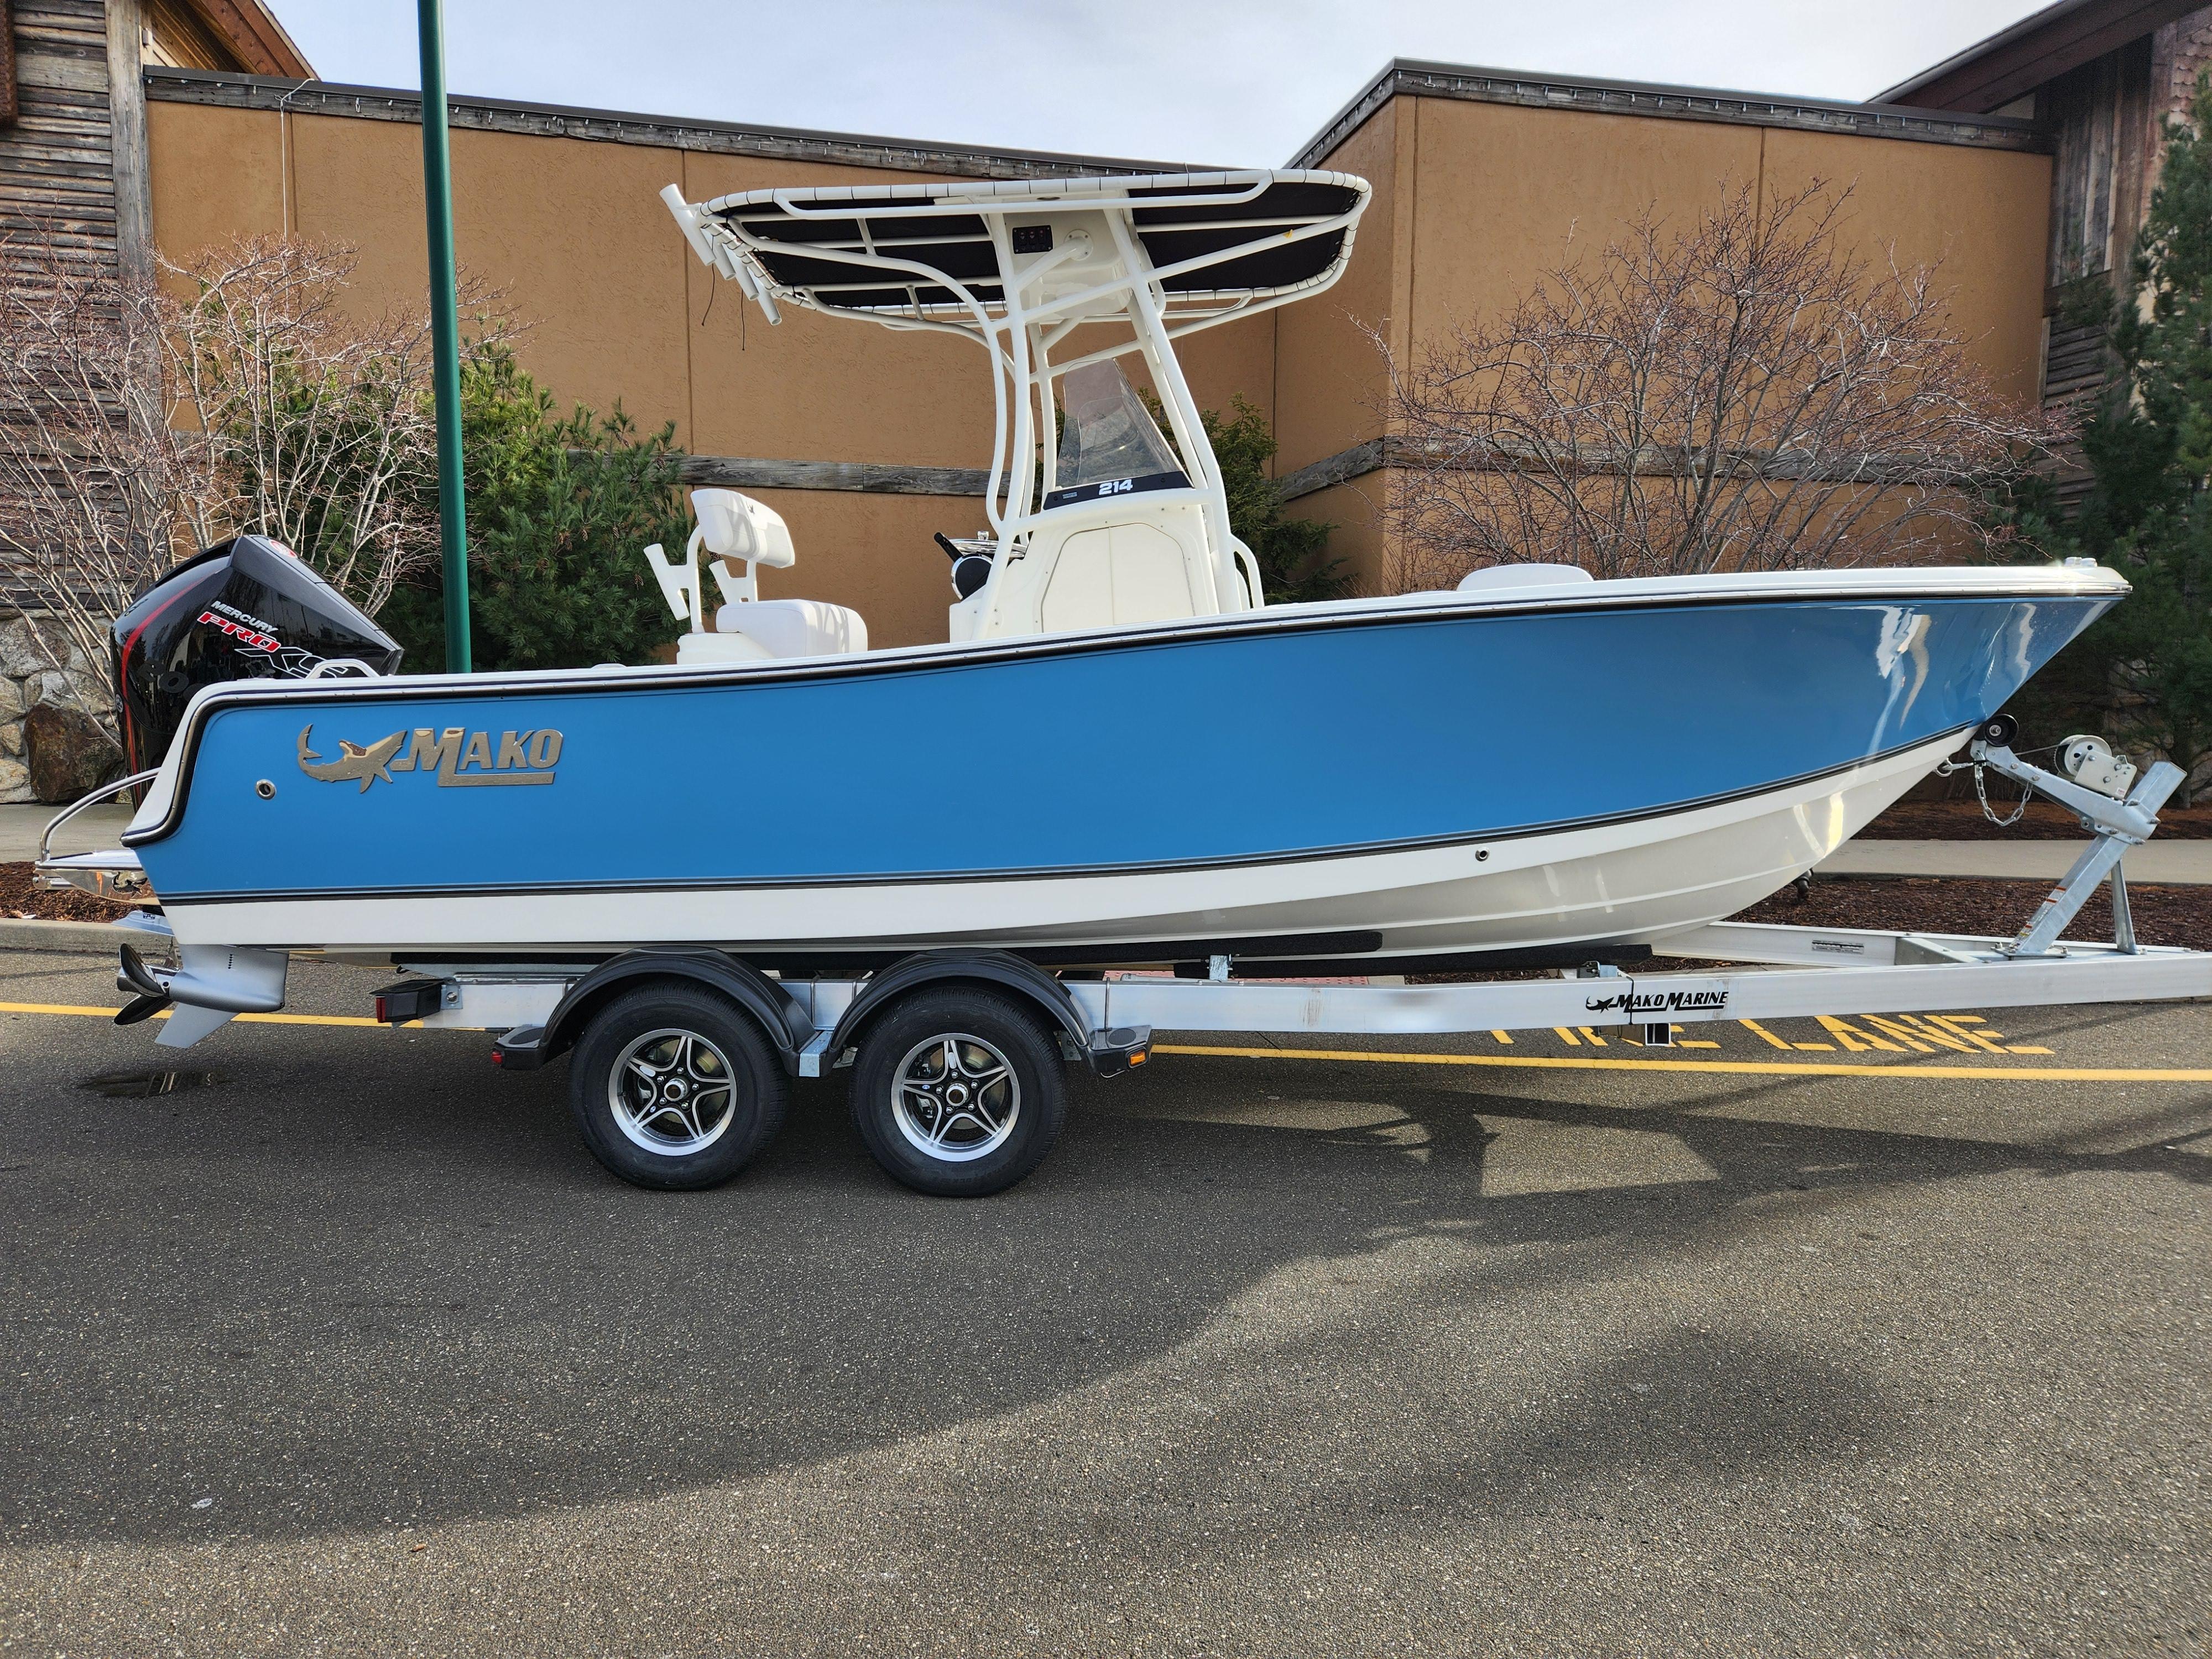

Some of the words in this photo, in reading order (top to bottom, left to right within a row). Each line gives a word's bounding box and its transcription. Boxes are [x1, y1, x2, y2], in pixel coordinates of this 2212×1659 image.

[1099, 479, 1133, 495] 214
[197, 611, 281, 653] PRO
[211, 601, 279, 634] MERCURY
[389, 727, 564, 787] MAKO
[1608, 994, 1667, 1013] MAKO
[1665, 991, 1729, 1011] MARINE
[1738, 1014, 2056, 1054] LANE
